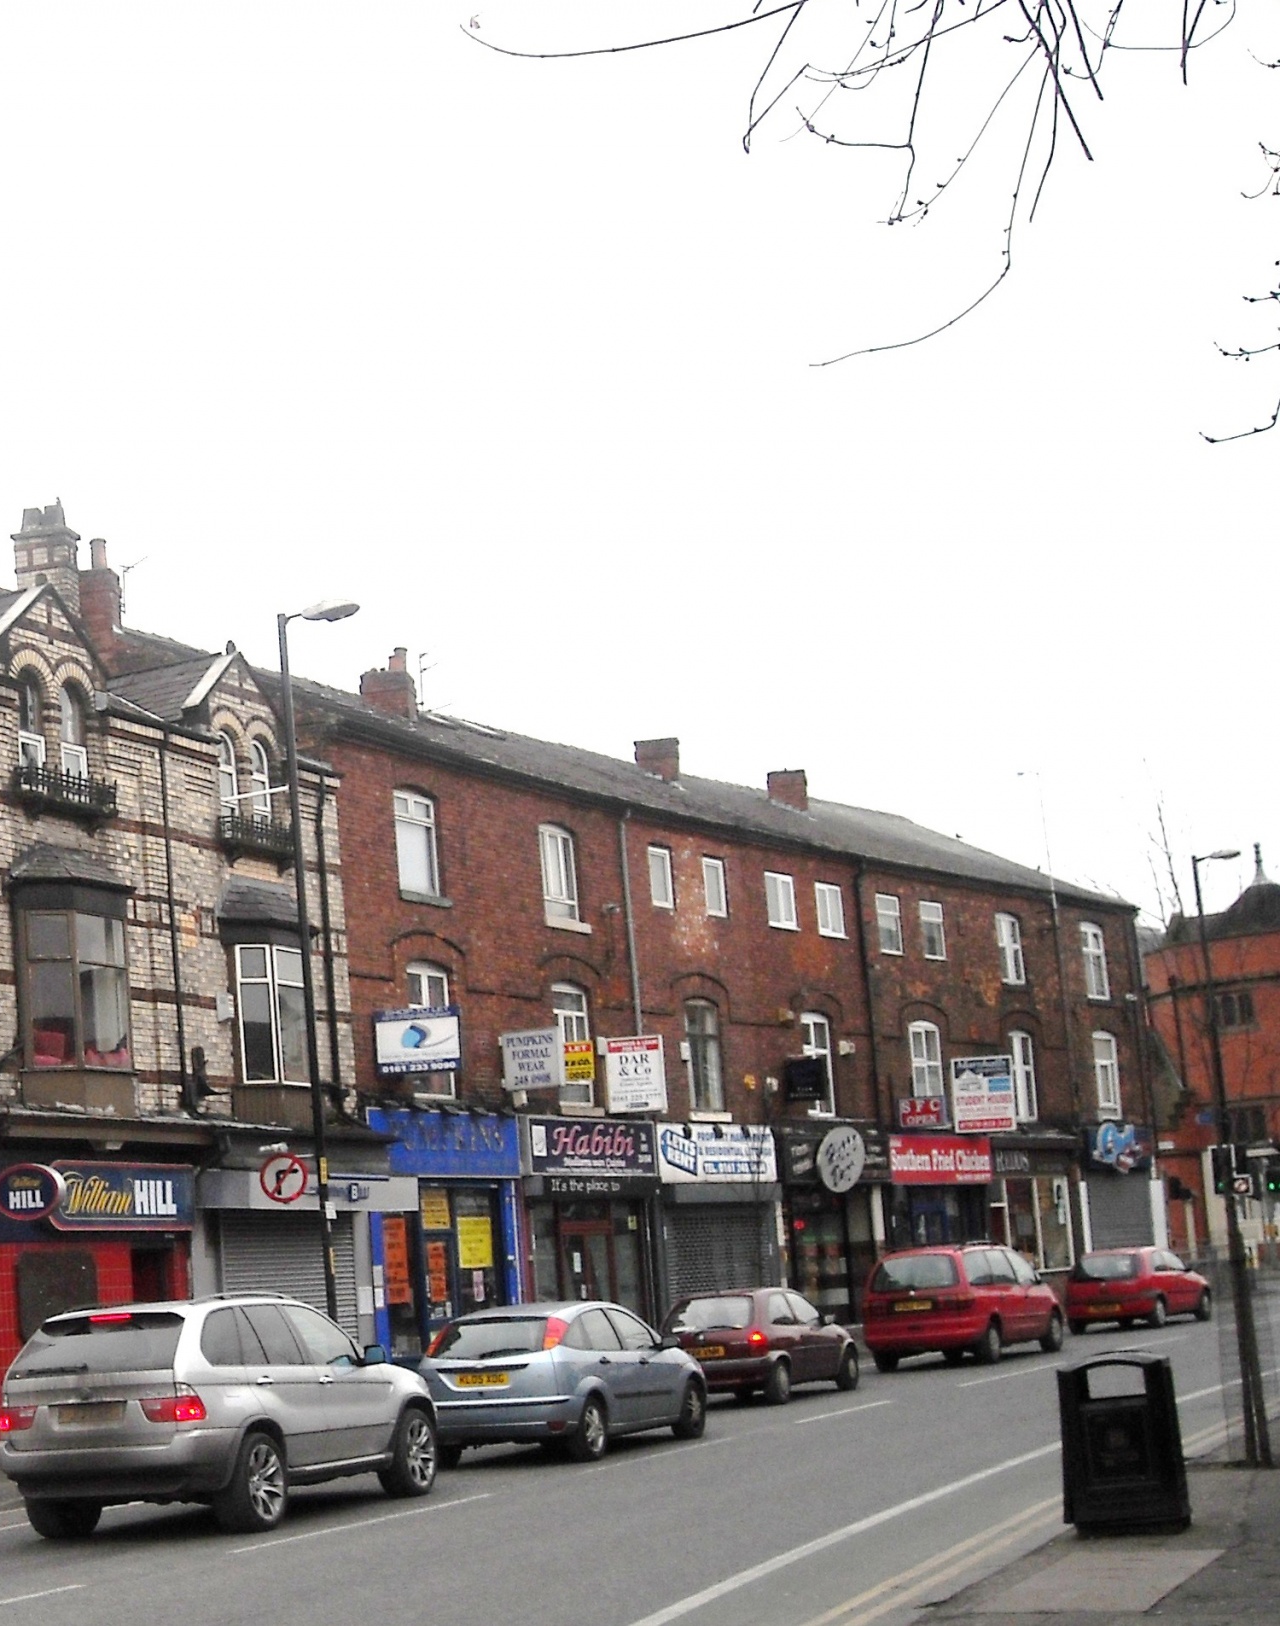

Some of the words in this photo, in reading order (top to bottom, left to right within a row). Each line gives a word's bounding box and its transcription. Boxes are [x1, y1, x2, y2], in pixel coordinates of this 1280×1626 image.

[506, 1033, 554, 1048] PUMPKINS
[512, 1047, 552, 1061] FORMAL
[619, 1053, 649, 1065] DAR
[518, 1060, 546, 1072] WEAR
[618, 1066, 629, 1077] &
[634, 1065, 652, 1076] Co
[551, 1124, 635, 1156] Habibi
[890, 1148, 931, 1171] Southern
[931, 1148, 955, 1171] Fried
[956, 1148, 990, 1171] Chicken
[64, 1173, 133, 1215] William
[134, 1180, 178, 1215] HILL
[569, 1179, 582, 1192] the
[586, 1179, 609, 1194] place
[9, 1190, 45, 1210] HILL
